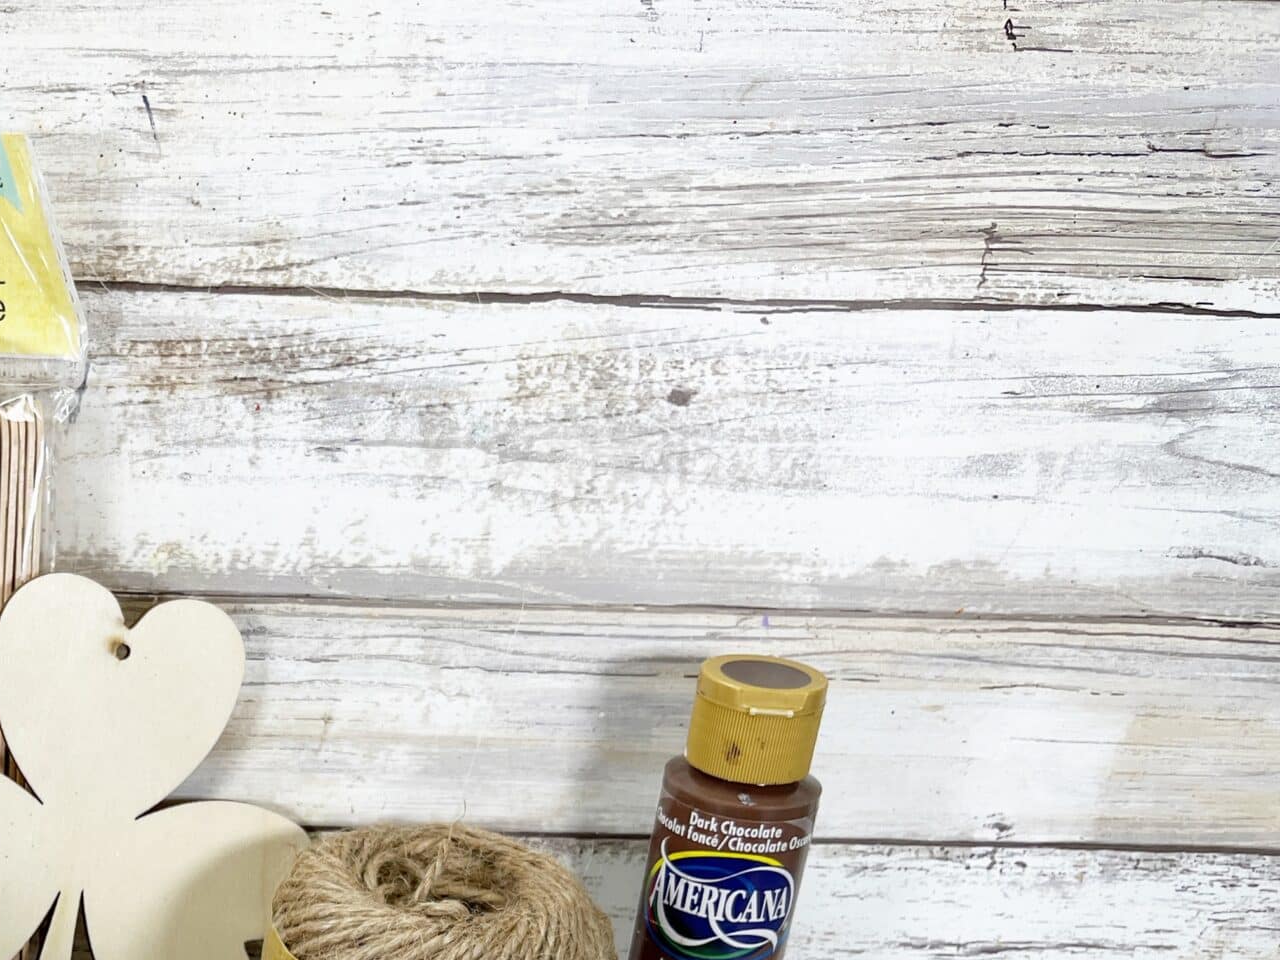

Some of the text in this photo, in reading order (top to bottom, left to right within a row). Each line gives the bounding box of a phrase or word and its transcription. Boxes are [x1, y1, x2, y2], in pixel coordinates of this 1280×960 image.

[689, 811, 783, 839] Dark Chocolate
[650, 860, 789, 923] AMERICANA
